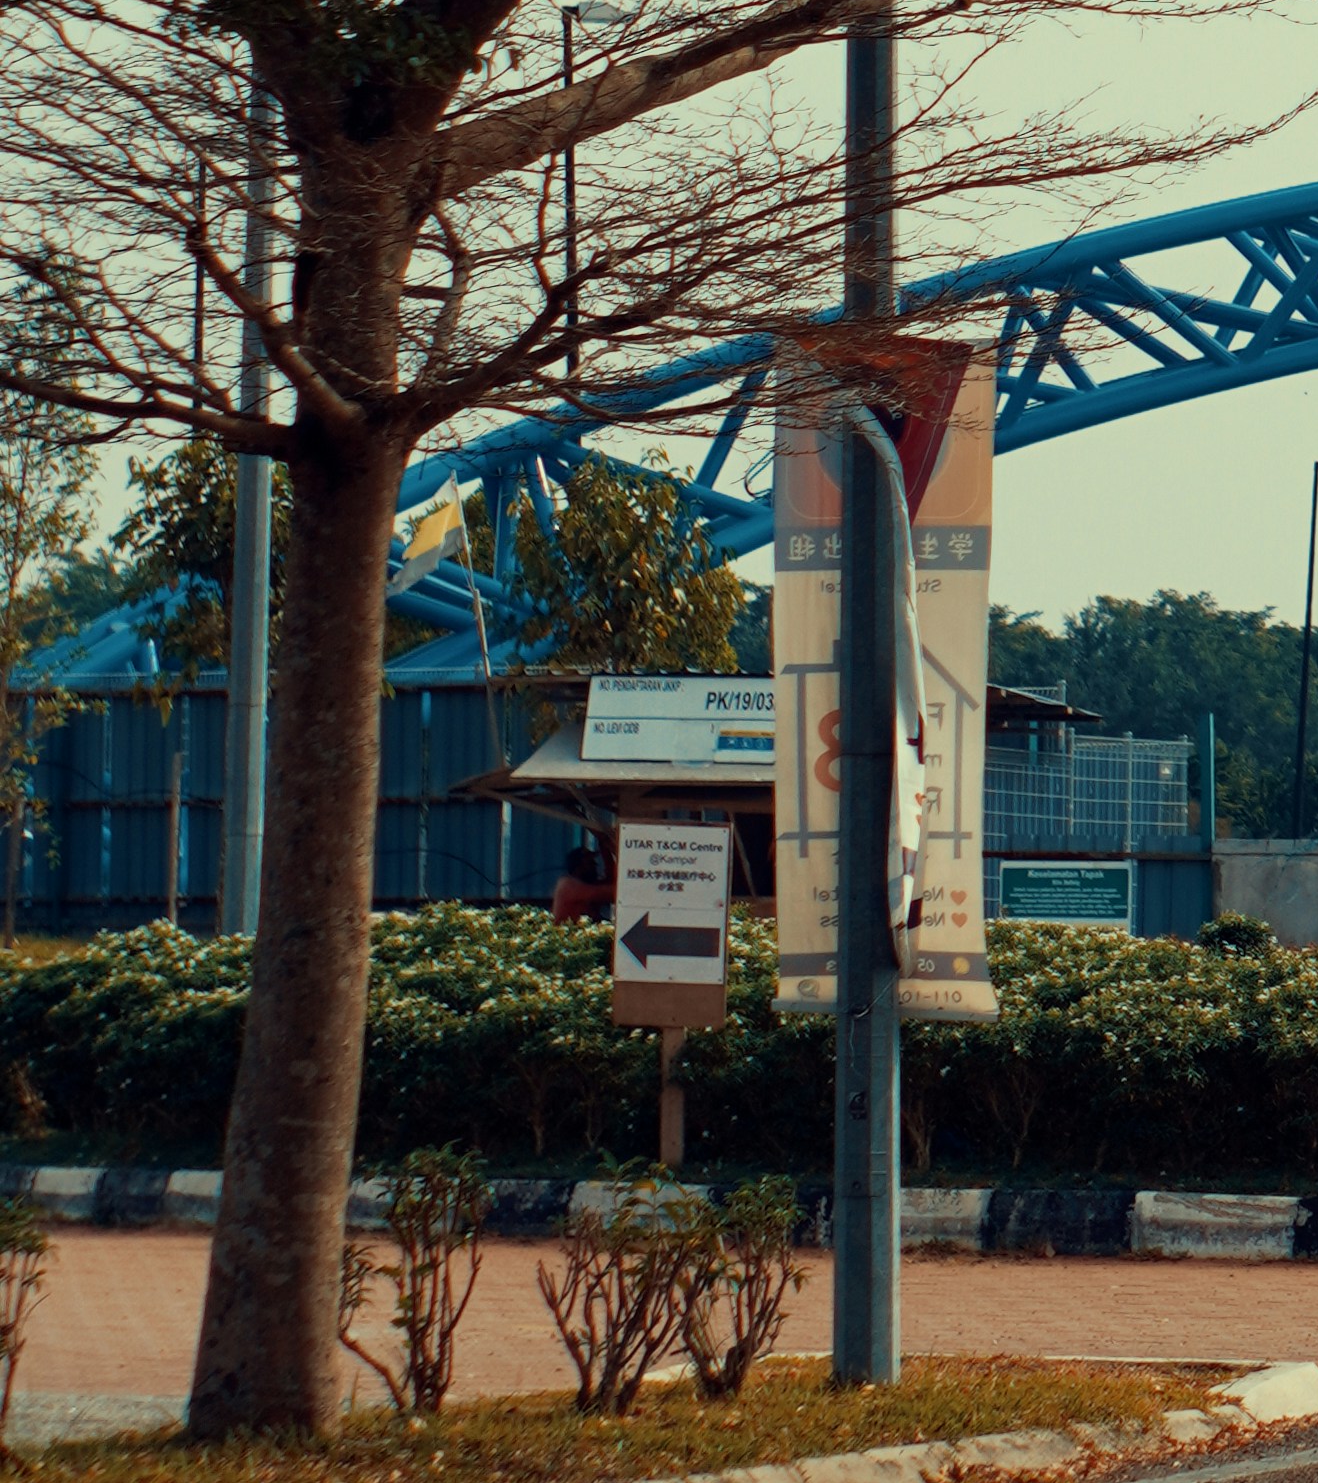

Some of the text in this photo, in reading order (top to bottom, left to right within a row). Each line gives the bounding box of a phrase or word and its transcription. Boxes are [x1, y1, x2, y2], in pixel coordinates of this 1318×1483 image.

[705, 691, 775, 711] PK/19/03
[625, 839, 723, 852] UTAR T&CM Centre
[649, 853, 698, 866] @Kampar
